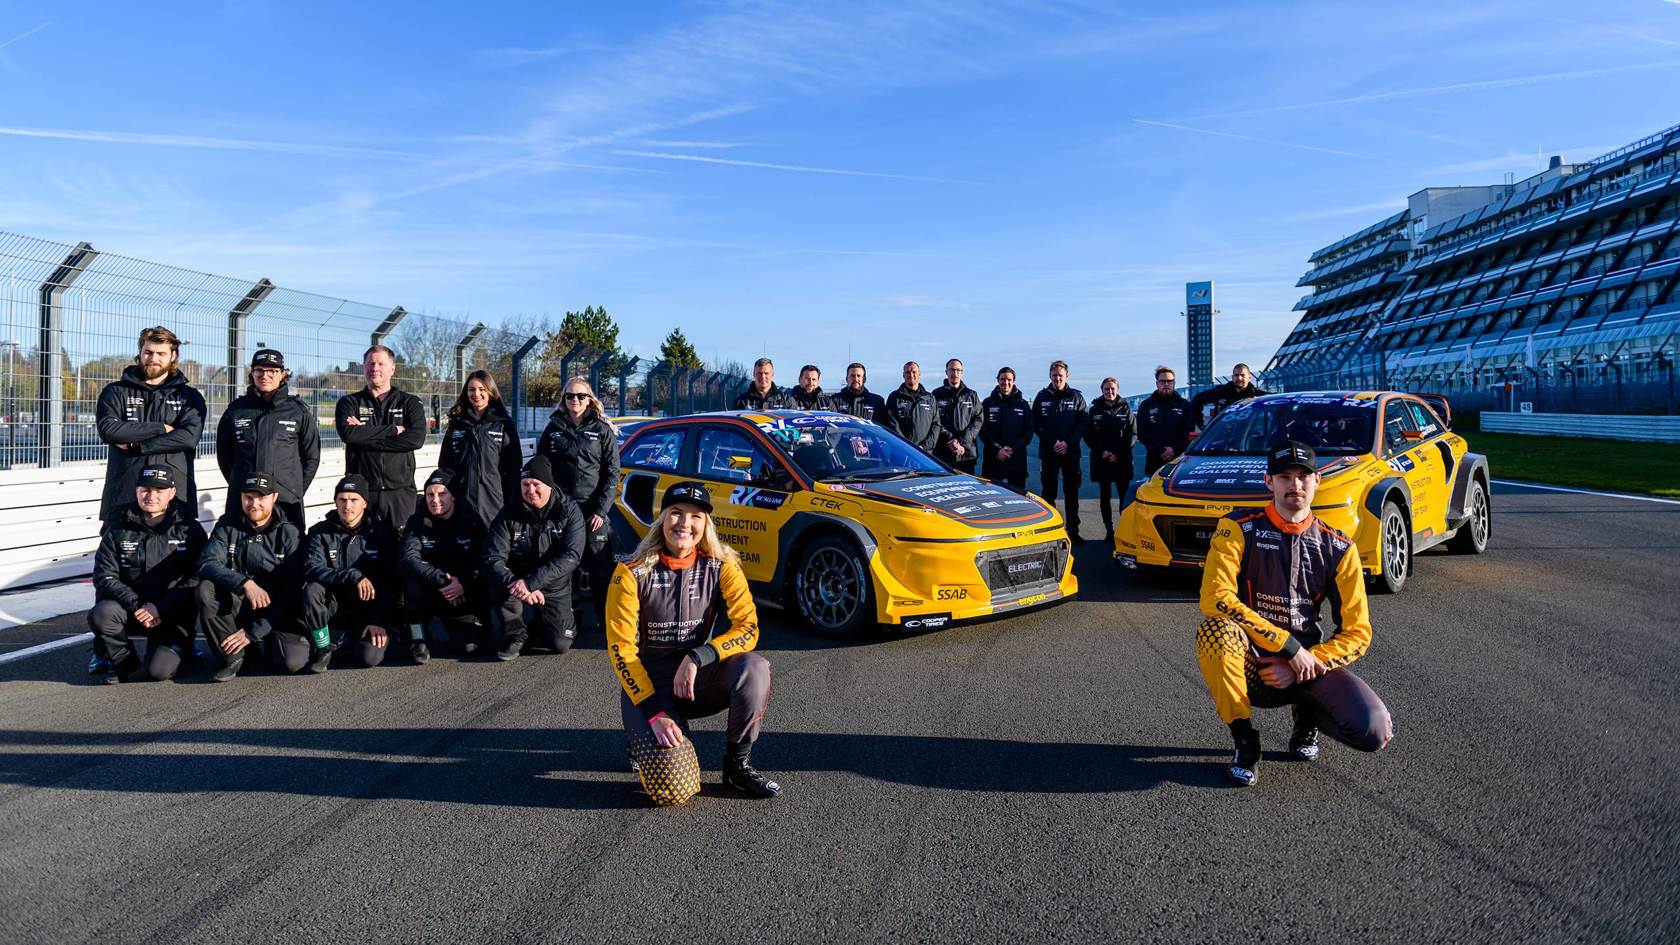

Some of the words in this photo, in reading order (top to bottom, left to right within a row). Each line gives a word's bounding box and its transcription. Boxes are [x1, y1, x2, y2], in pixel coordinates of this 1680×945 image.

[810, 497, 845, 511] CTEK
[718, 534, 749, 545] PMENT
[740, 551, 760, 563] EAM
[1008, 560, 1042, 573] ELECTRIC
[937, 589, 967, 600] SSAB
[921, 616, 948, 624] COOPER
